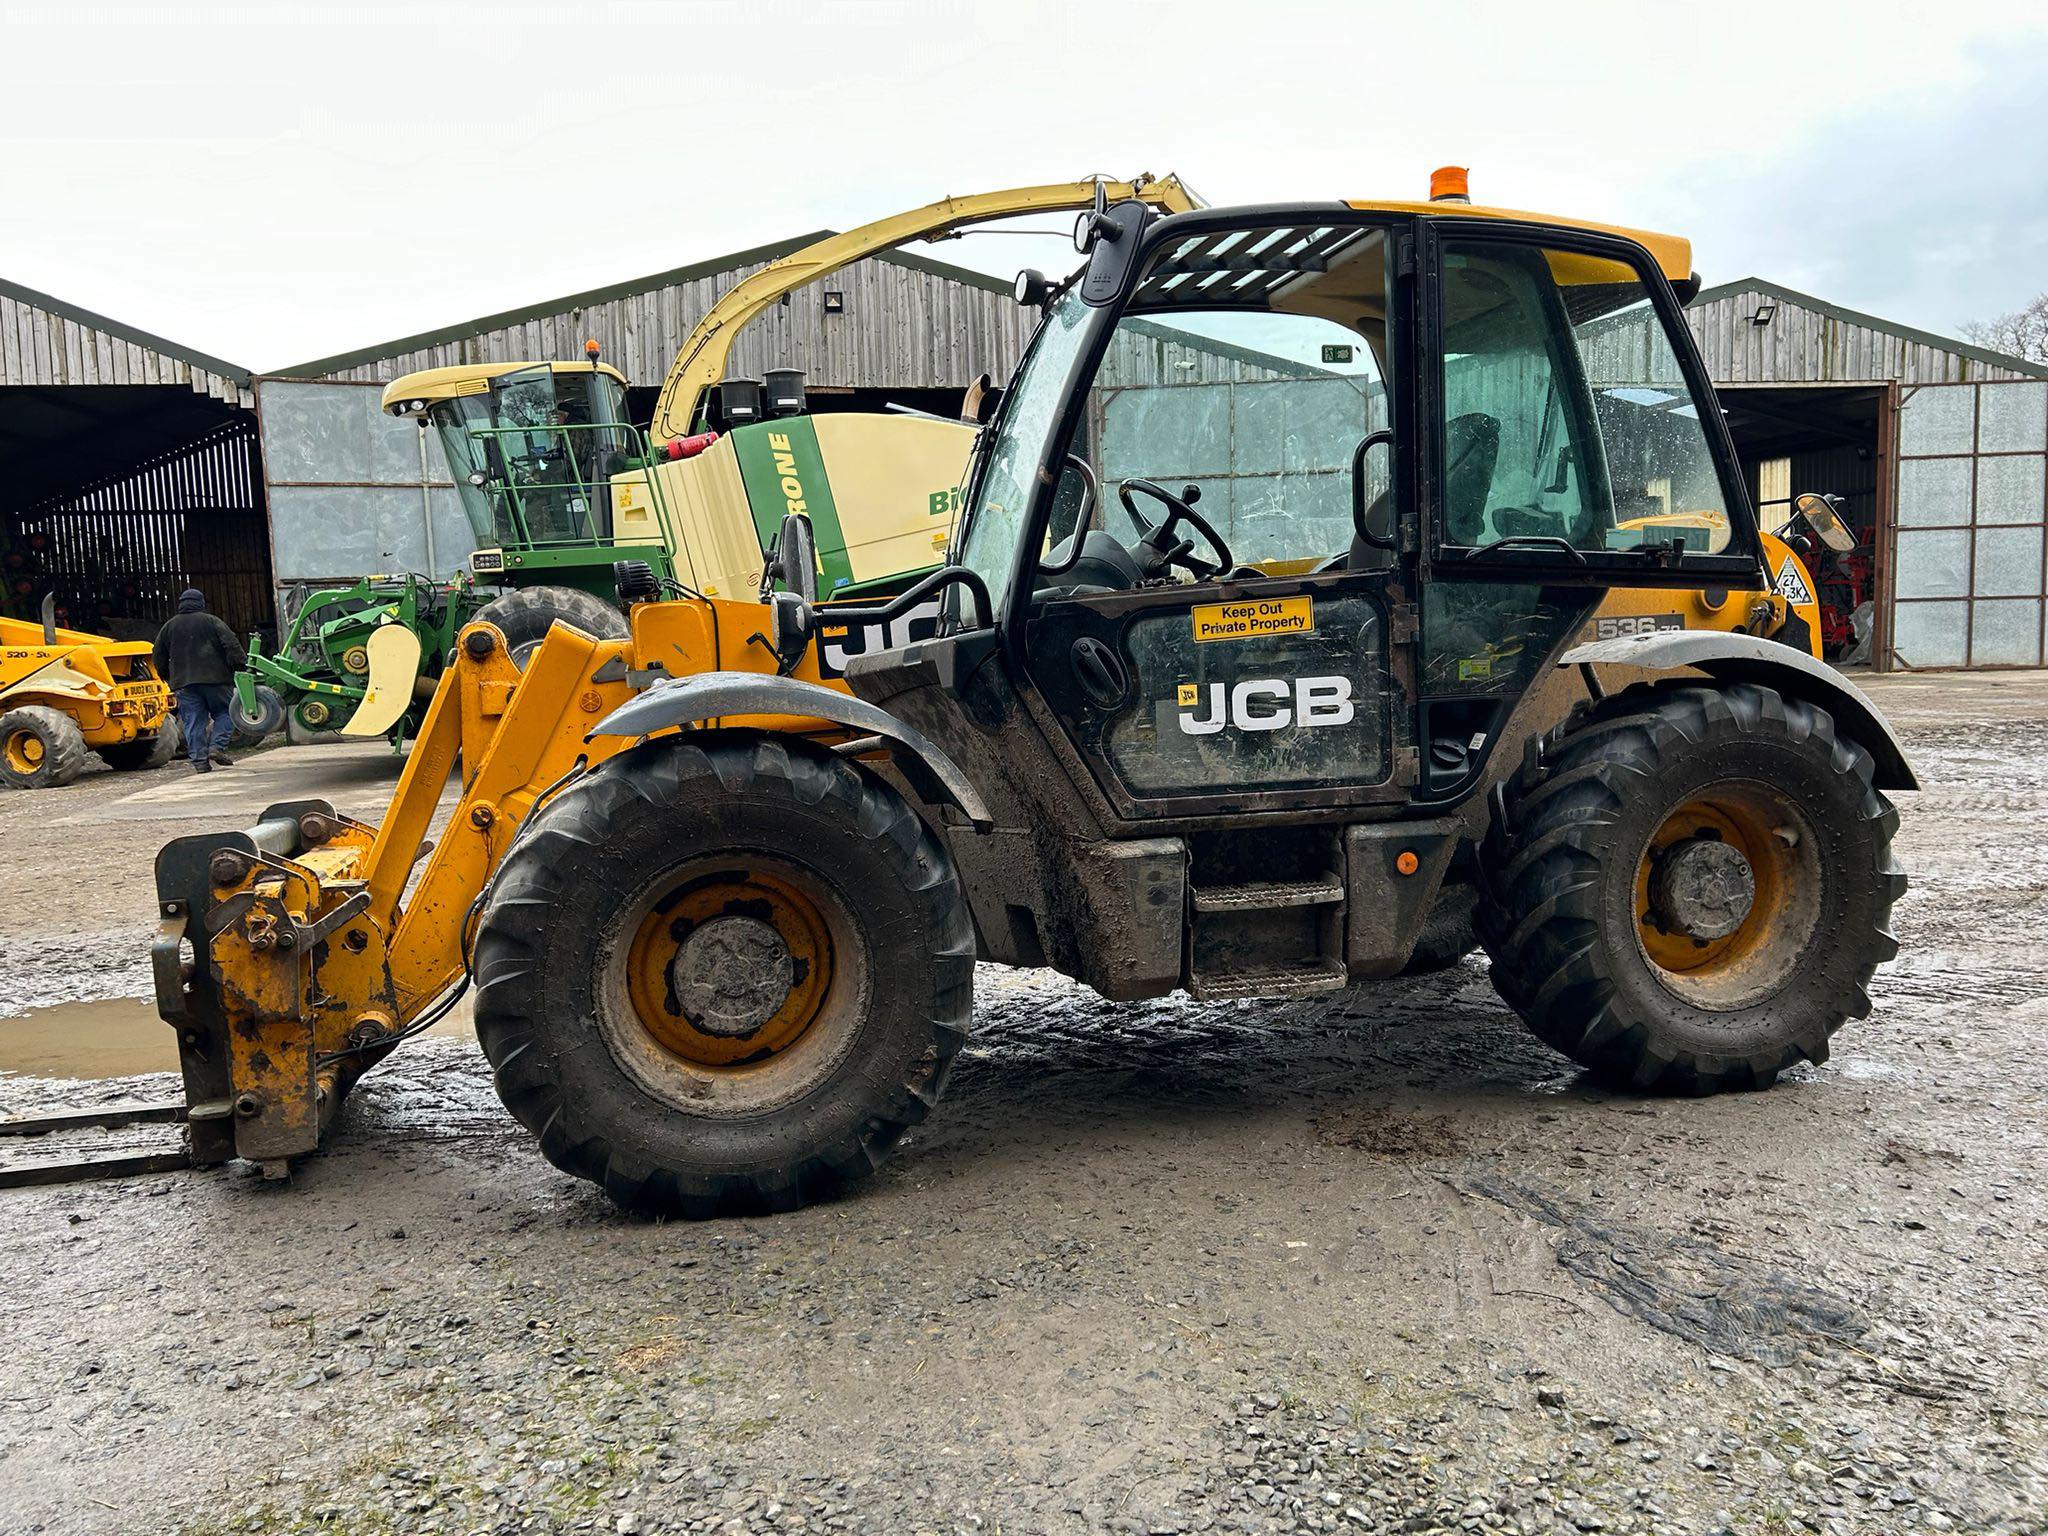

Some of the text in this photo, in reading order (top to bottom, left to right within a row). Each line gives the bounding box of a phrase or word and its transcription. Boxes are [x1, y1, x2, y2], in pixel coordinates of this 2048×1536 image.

[1222, 603, 1283, 619] Keep Out
[1201, 615, 1305, 635] Private Property
[1178, 676, 1355, 735] JCB
